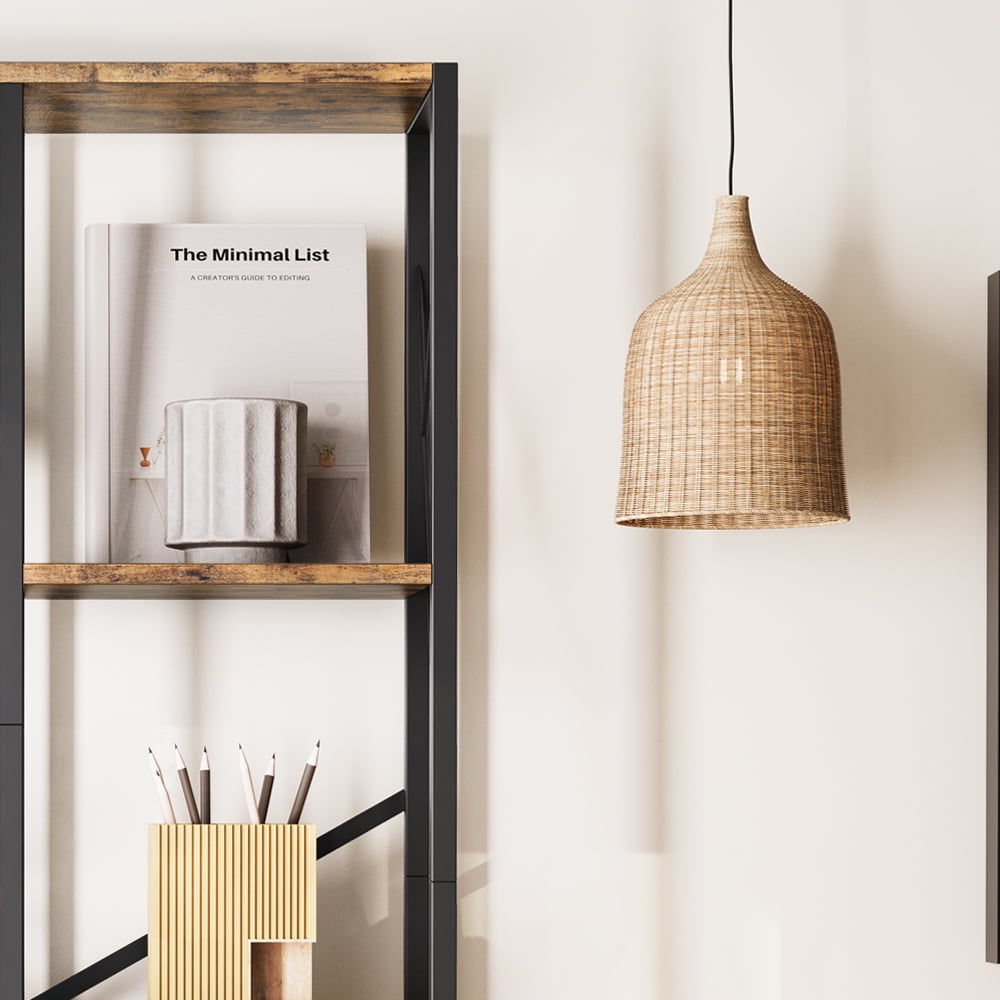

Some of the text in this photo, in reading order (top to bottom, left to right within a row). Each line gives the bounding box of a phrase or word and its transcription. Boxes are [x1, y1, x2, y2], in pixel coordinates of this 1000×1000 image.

[170, 247, 331, 262] The Minimal List
